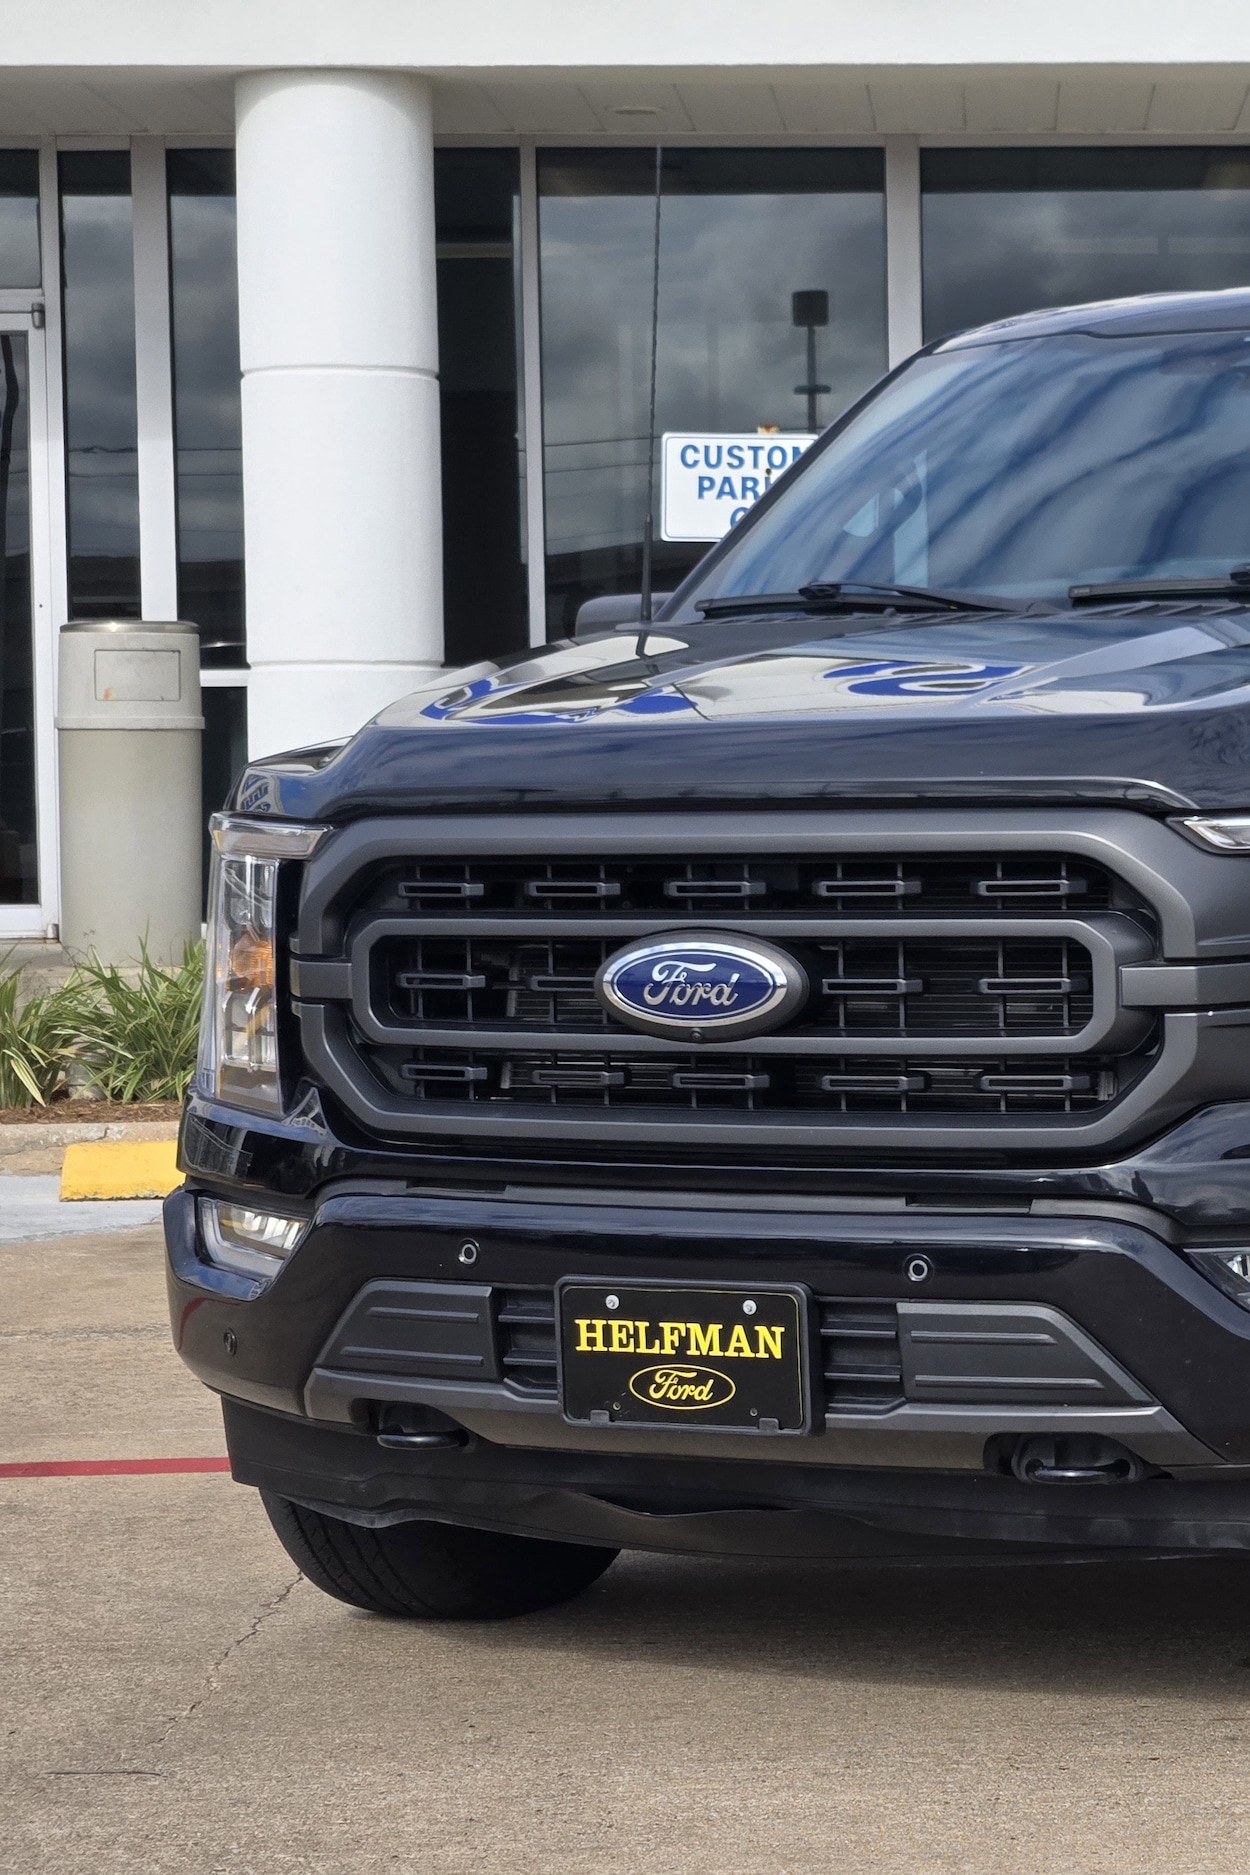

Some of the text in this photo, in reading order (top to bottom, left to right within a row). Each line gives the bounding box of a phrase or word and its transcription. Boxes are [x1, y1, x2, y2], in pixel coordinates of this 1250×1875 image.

[643, 960, 741, 1006] Ford
[574, 1318, 786, 1360] HELFMAN
[649, 1369, 715, 1401] Ford
